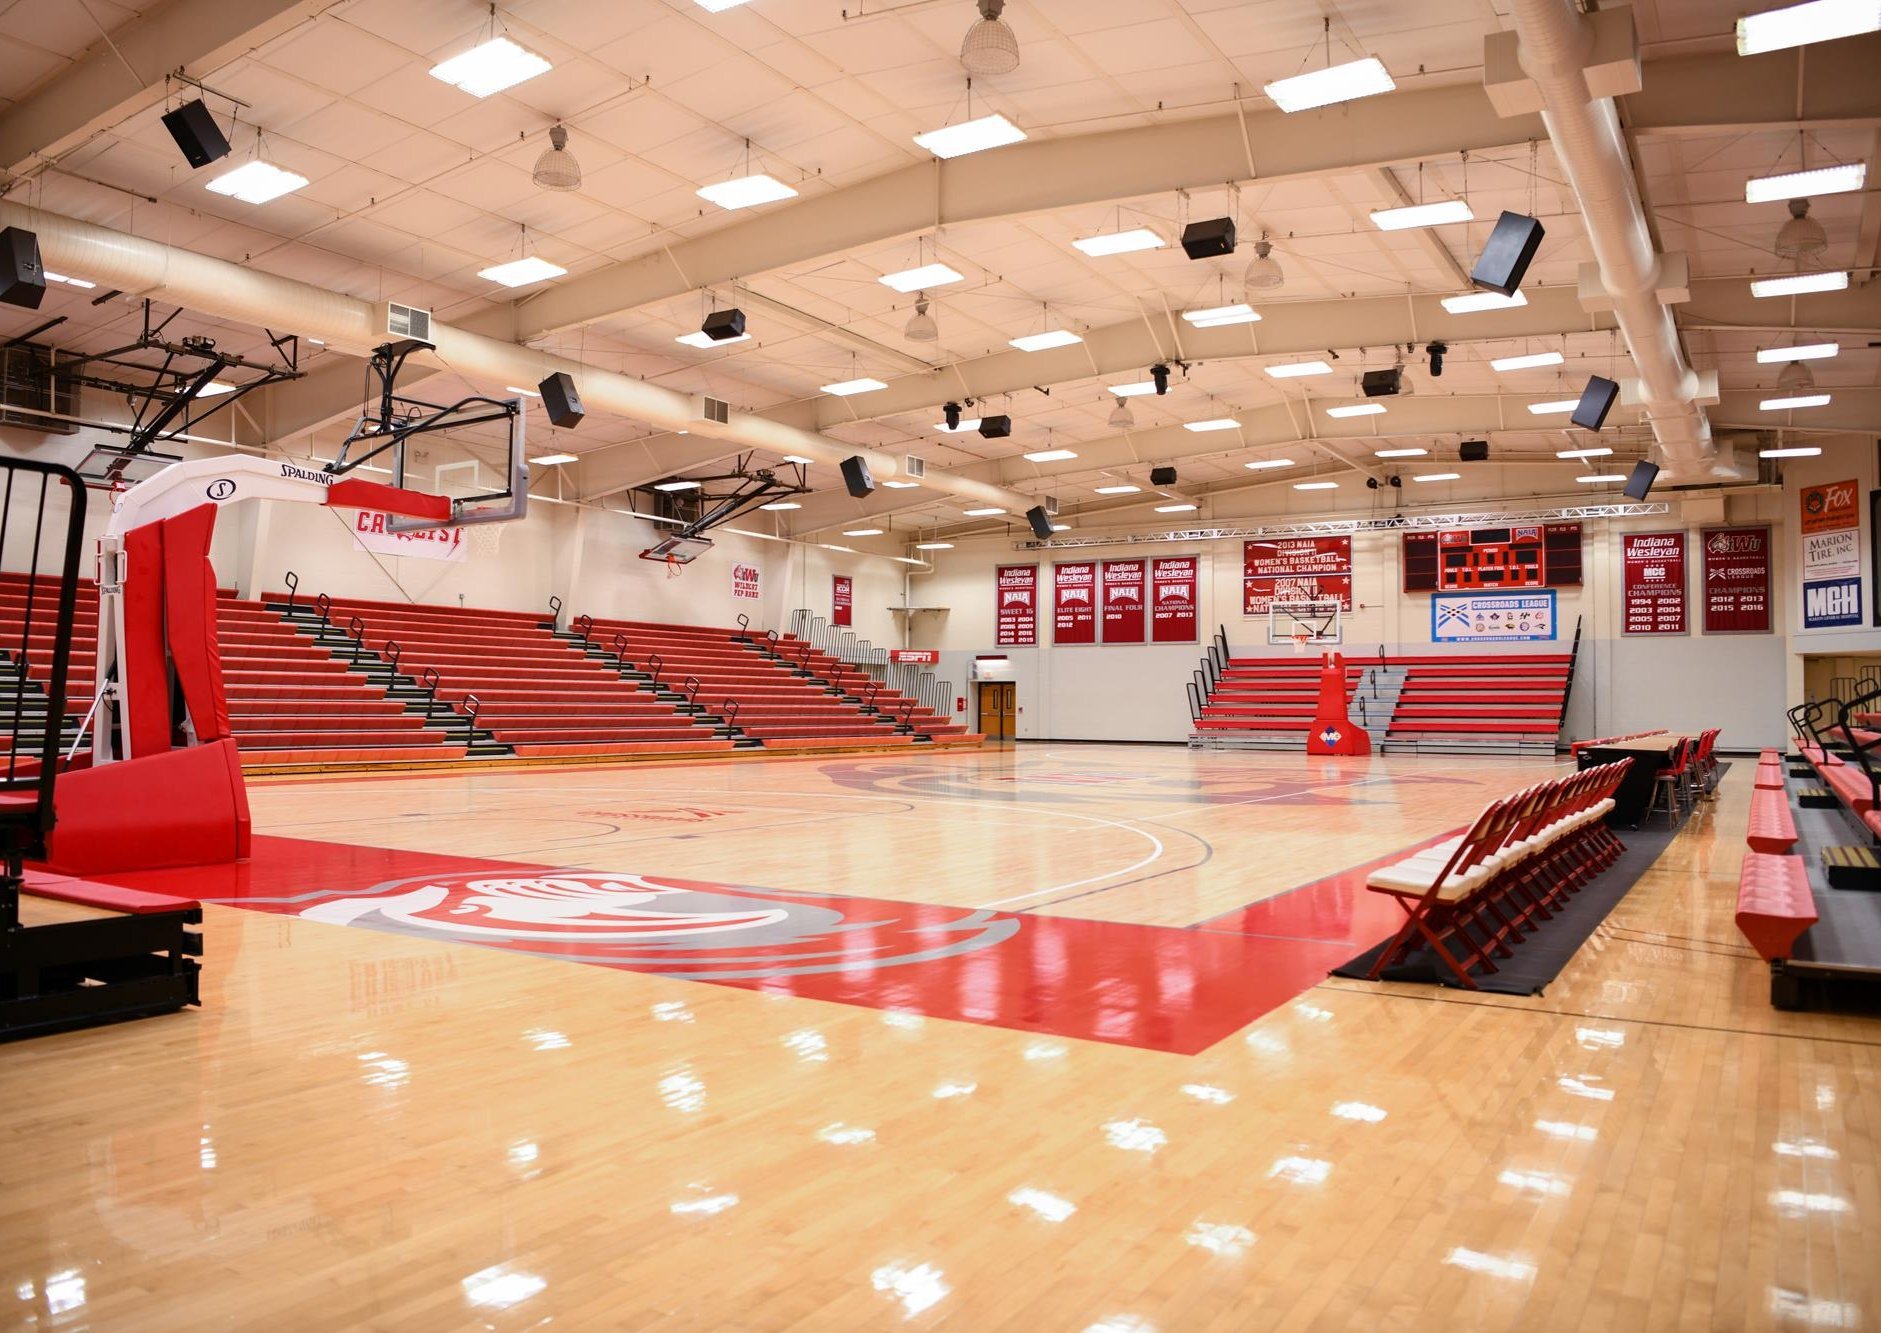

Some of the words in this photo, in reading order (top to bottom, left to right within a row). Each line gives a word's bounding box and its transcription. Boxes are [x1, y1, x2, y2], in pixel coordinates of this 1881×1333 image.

[281, 464, 333, 486] SPALDING
[1517, 529, 1537, 537] NAIA
[1633, 538, 1674, 547] Indiana
[1810, 532, 1852, 550] MARION
[1627, 547, 1680, 557] Wesleyan
[1160, 561, 1190, 569] Indiana
[1254, 558, 1287, 566] WOMEN'S
[1289, 555, 1339, 564] BASKETBALL
[1155, 569, 1193, 578] Wesleyan
[1258, 566, 1294, 574] NATIONAL
[1296, 564, 1337, 572] CHAMPION
[1644, 568, 1665, 576] MCC
[1105, 572, 1142, 580] Wesleyan
[1000, 577, 1033, 585] Wesleyan
[1275, 579, 1296, 587] 2007
[1297, 578, 1317, 586] NAIA
[1062, 590, 1086, 599] NAIA
[1111, 588, 1136, 599] NAIA
[1161, 586, 1188, 596] NAIA
[1004, 593, 1028, 602] NAIA
[1807, 584, 1858, 617] MGH
[1472, 600, 1519, 609] CROSSROADS
[1522, 600, 1548, 608] LEAGUE
[898, 652, 932, 661] ESPN
